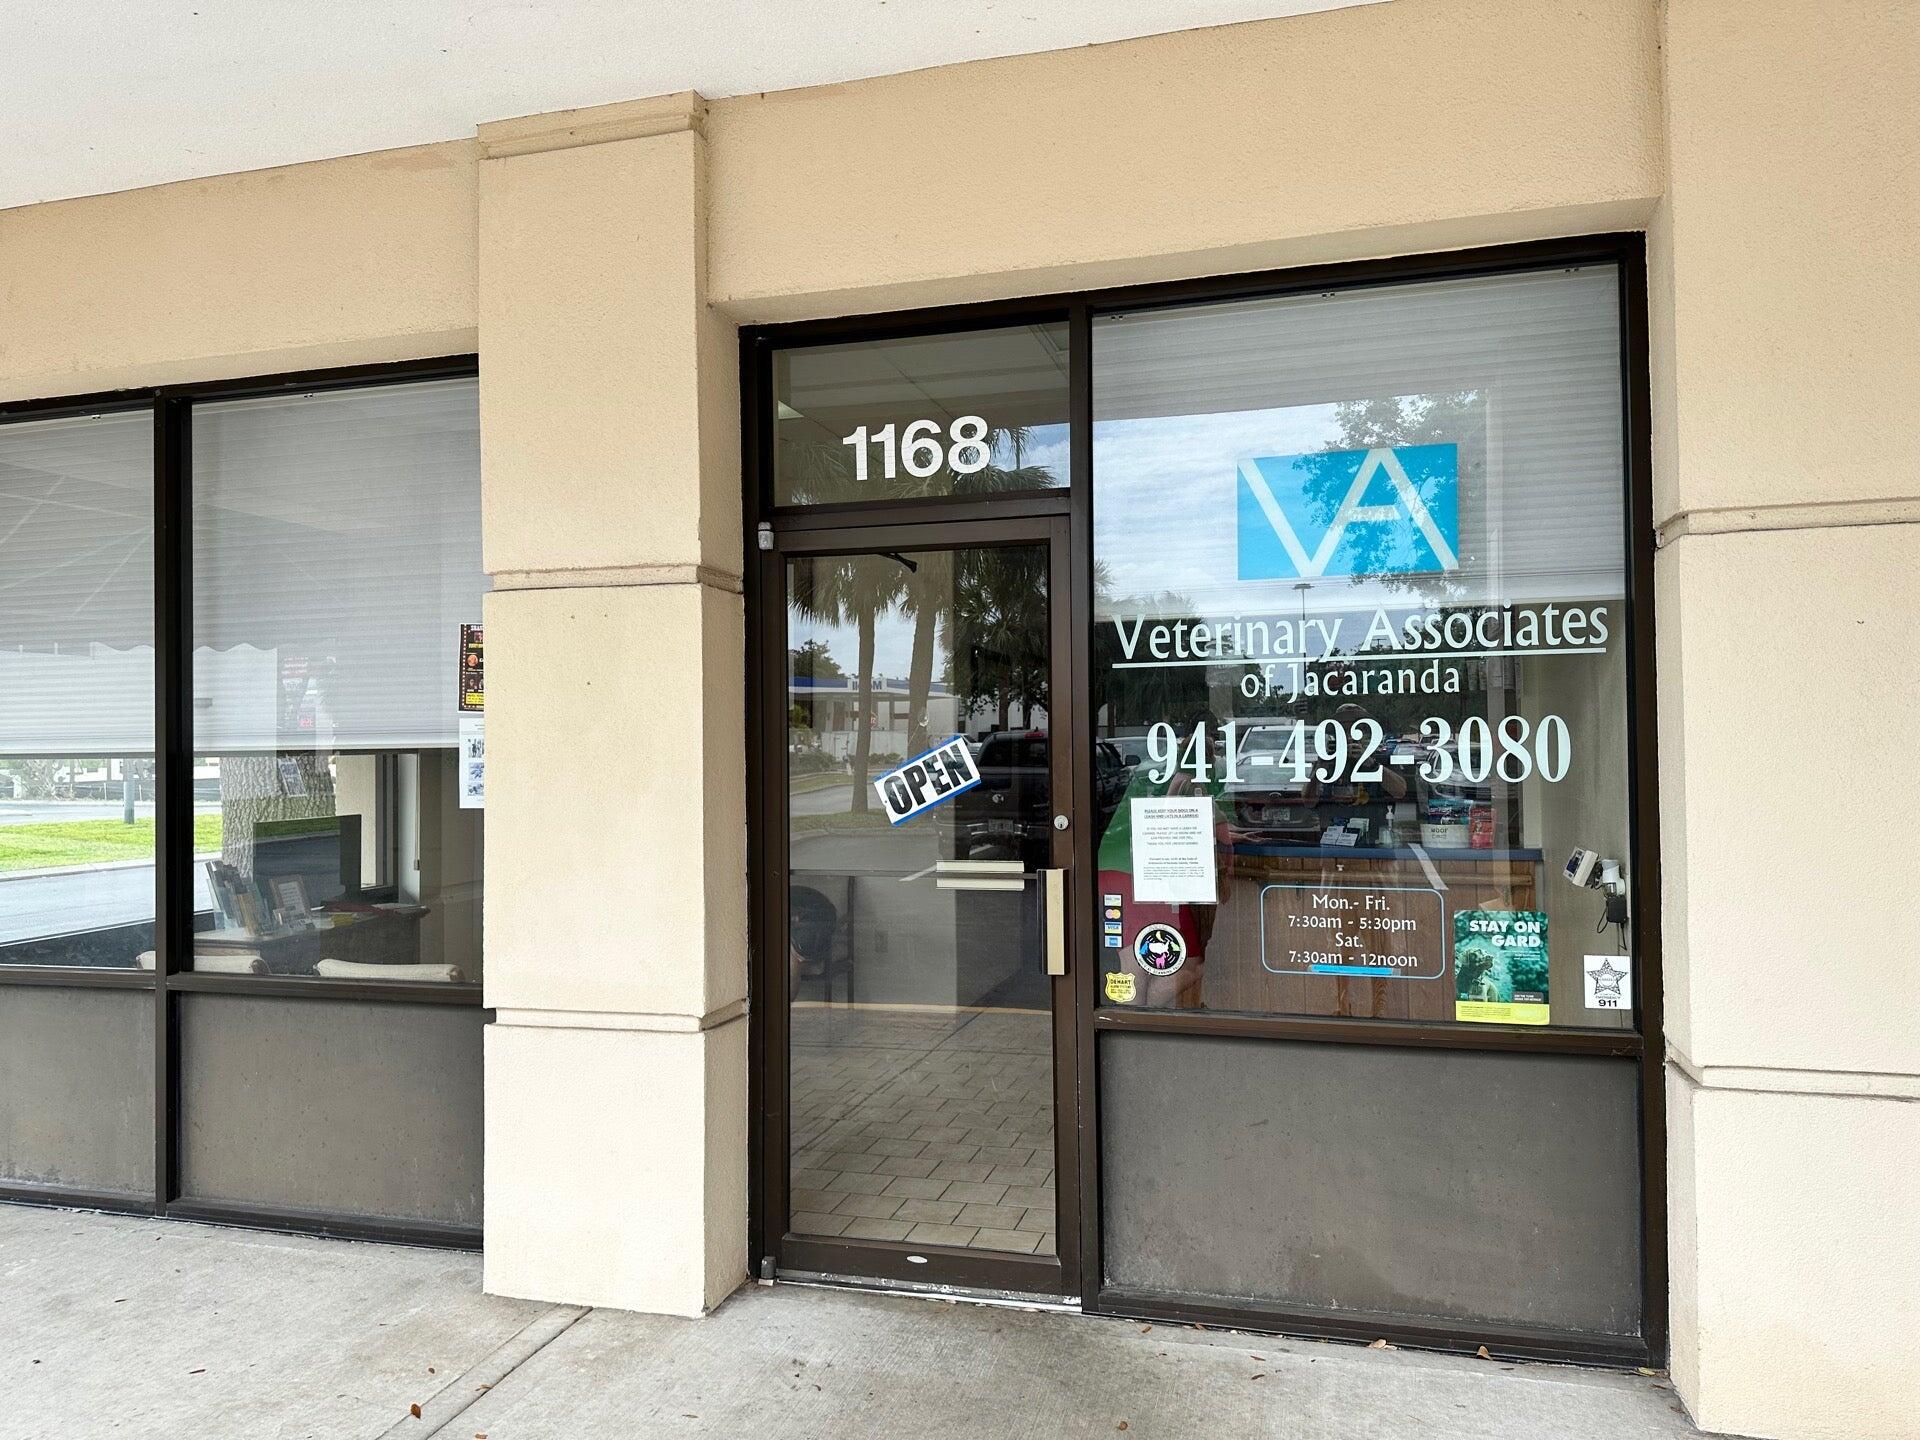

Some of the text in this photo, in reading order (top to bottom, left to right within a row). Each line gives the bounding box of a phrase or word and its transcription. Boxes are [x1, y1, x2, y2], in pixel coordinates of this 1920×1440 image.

[842, 415, 991, 481] 1168
[1238, 446, 1459, 578] VA
[1112, 604, 1609, 662] Veterinary Associates
[1240, 659, 1461, 704] of Jacaranda
[1146, 714, 1572, 784] 941-492-3080
[884, 743, 973, 815] OPEN
[1365, 895, 1390, 911] Fri.
[1288, 915, 1342, 928] 7:30am
[1359, 917, 1416, 932] 5:30pm
[1469, 920, 1541, 933] STAY ON
[1335, 932, 1364, 948] Sat.
[1491, 934, 1541, 947] GARD
[1288, 950, 1343, 964] 7:30am
[1360, 953, 1418, 967] 12noon
